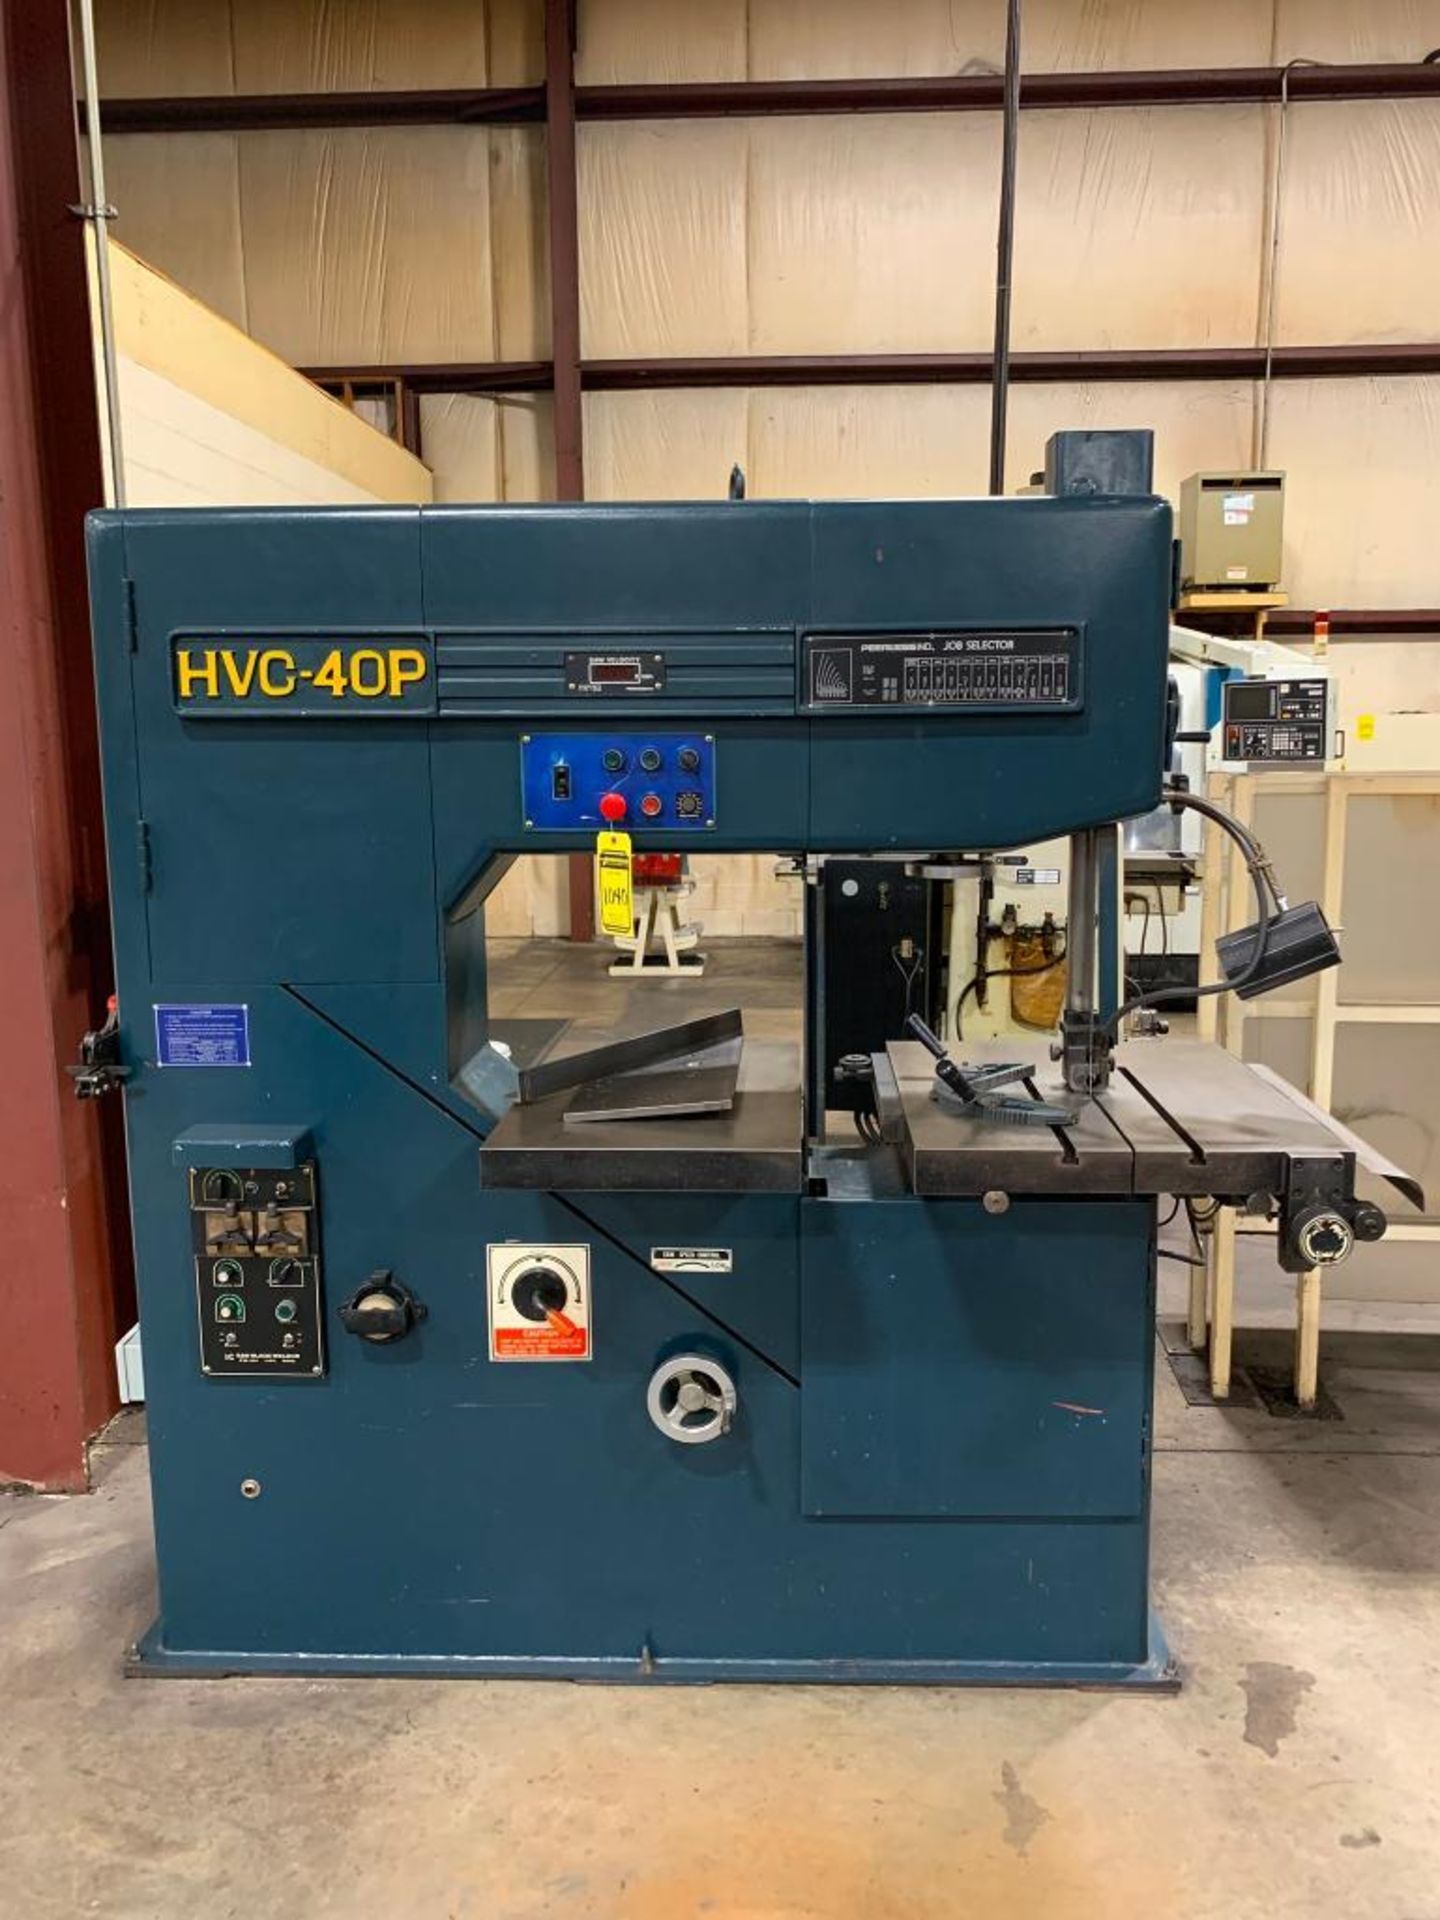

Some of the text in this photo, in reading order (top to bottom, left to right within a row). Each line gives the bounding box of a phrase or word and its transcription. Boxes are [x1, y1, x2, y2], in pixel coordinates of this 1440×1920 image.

[943, 641, 963, 650] JOB
[966, 640, 1014, 650] SELECTOR
[177, 650, 426, 697] HVC-40P
